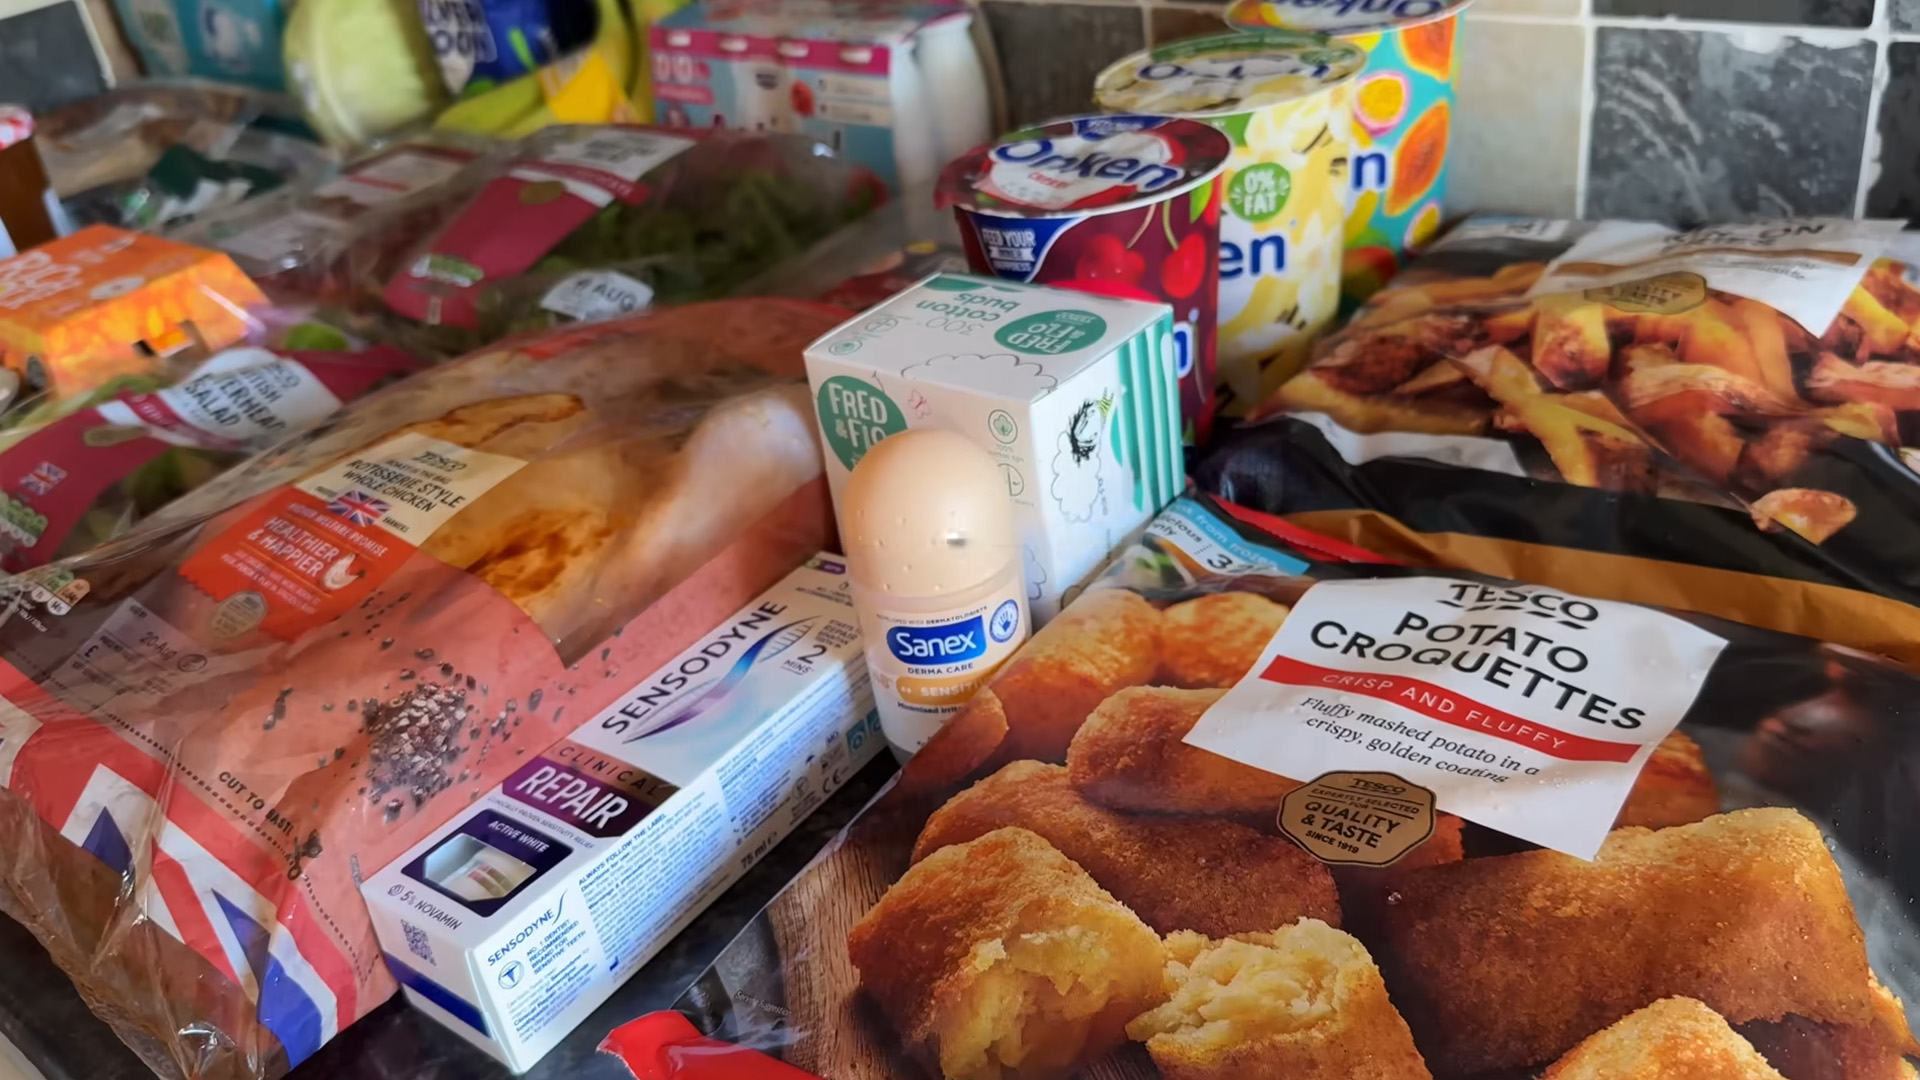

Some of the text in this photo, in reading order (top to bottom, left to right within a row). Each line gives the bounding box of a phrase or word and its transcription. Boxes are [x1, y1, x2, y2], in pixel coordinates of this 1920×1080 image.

[995, 140, 1179, 189] Onken
[1243, 169, 1275, 194] 0%
[1243, 194, 1277, 216] FAT
[1003, 228, 1036, 248] YOUR
[915, 300, 1001, 323] cotton
[954, 292, 1022, 313] buds
[1006, 332, 1072, 354] FRED
[185, 381, 242, 427] SALAD
[827, 382, 888, 425] FRED
[342, 470, 385, 493] WHOLE
[382, 485, 437, 513] CHICKEN
[347, 459, 466, 509] ROTISSERIE STYLE
[247, 528, 265, 541] &
[259, 535, 325, 577] HAPPIER
[263, 516, 340, 562] HEALTHIER
[349, 531, 389, 558] PROMISE
[1195, 514, 1229, 544] from
[1229, 542, 1280, 572] frozen
[1449, 583, 1599, 623] TESCO
[139, 630, 178, 662] 20-Aug
[797, 644, 828, 665] 2
[896, 630, 978, 658] Sanex
[1392, 611, 1589, 673] POTATO
[601, 600, 788, 735] SENSODYNE
[783, 659, 812, 675] MINS
[907, 662, 975, 676] DERMA CARE
[1310, 620, 1646, 730] CROQUETTES
[897, 701, 940, 715] Minimised
[1322, 674, 1566, 750] CRISP AND FLUFFY
[1300, 696, 1541, 776] Fluffy mashed potato in a
[1305, 717, 1512, 784] crispy, golden coating
[558, 746, 660, 797] CLINICAL
[1348, 777, 1407, 795] TESCO
[218, 770, 247, 795] CUT
[246, 791, 266, 811] TO
[516, 764, 629, 830] REPAIR
[1311, 788, 1420, 815] EXPERTLY SELECTED
[1348, 800, 1369, 810] FOR
[1300, 813, 1383, 849] & TASTE
[1304, 801, 1402, 834] QUALITY
[488, 819, 551, 854] ACTIVE WHITE
[578, 813, 667, 886] ALWAYS FOLLOW THE LABEL
[1305, 830, 1360, 854] SINCE 1919
[740, 852, 756, 869] 75
[415, 899, 463, 931] NOVAMIN
[543, 918, 571, 944] DENTIST
[487, 908, 556, 967] SENSODYNE
[528, 920, 580, 963] RECOMMENDED
